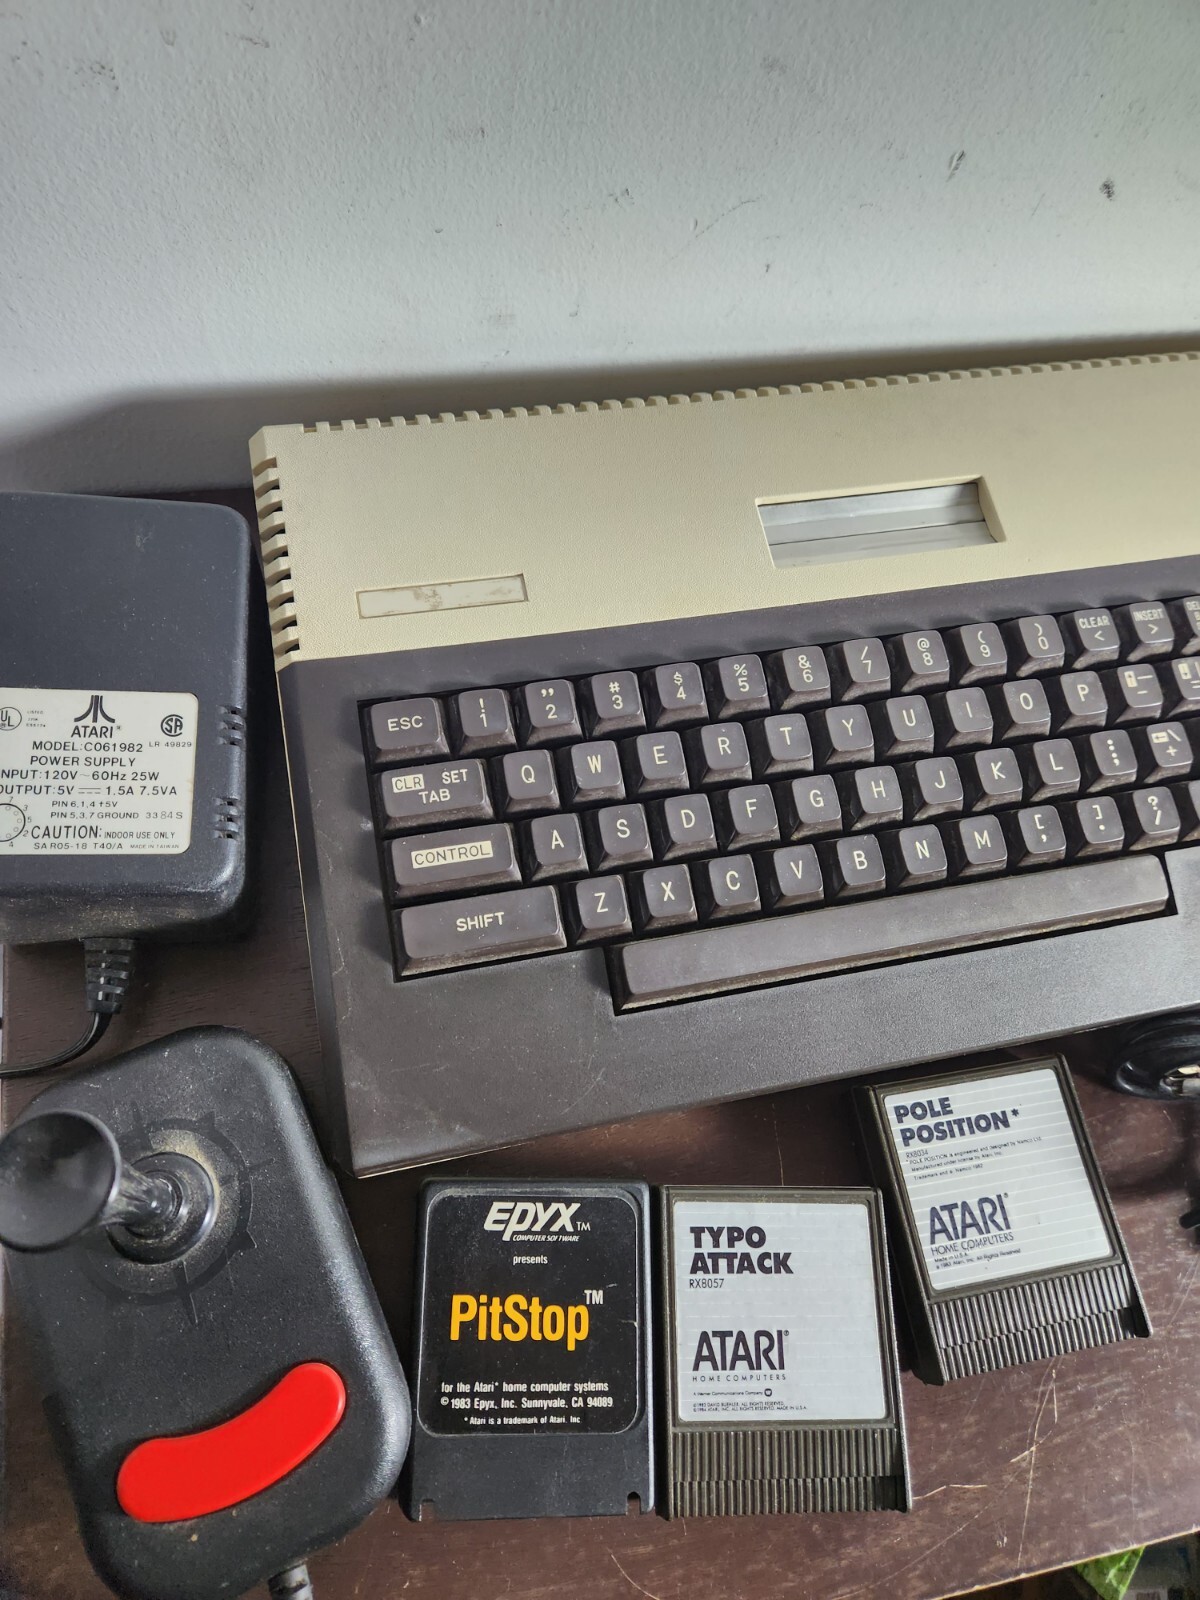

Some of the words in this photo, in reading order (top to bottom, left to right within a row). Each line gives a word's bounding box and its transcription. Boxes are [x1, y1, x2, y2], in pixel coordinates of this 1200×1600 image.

[1079, 616, 1109, 628] CLEAR
[1133, 608, 1163, 621] INSERT
[980, 645, 991, 658] 9
[1038, 636, 1049, 650] 0
[862, 660, 872, 674] 7
[923, 652, 933, 666] 8
[803, 669, 813, 683] 6
[677, 687, 686, 699] 4
[738, 678, 749, 692] 5
[1077, 684, 1089, 701] P
[612, 695, 623, 709] 3
[966, 702, 972, 718] I
[1020, 693, 1033, 710] O
[546, 704, 557, 719] 2
[903, 709, 916, 727] U
[387, 716, 423, 731] ESC
[480, 714, 487, 727] 1
[842, 719, 854, 736] Y
[71, 726, 113, 738] ATARI
[780, 727, 792, 745] T
[718, 737, 731, 755] R
[30, 756, 79, 765] POWER
[84, 757, 135, 767] SUPPLY
[653, 746, 668, 764] E
[1050, 753, 1063, 771] L
[587, 755, 602, 773] W
[991, 762, 1006, 779] K
[92, 771, 126, 780] 60Hz
[131, 772, 159, 781] 25W
[394, 776, 422, 790] CLR
[441, 769, 468, 785] SET
[521, 765, 535, 784] Q
[935, 771, 945, 788] J
[106, 786, 134, 795] 1.5A
[140, 786, 177, 795] 7.5VA
[418, 789, 450, 804] TAB
[871, 780, 886, 798] H
[810, 790, 824, 807] G
[746, 799, 757, 818] F
[681, 810, 695, 828] D
[31, 825, 103, 839] CAUTION:
[617, 819, 630, 838] S
[551, 830, 565, 849] A
[974, 830, 991, 849] M
[414, 844, 491, 865] CONTROL
[915, 840, 929, 859] N
[853, 851, 868, 869] B
[790, 861, 803, 879] V
[726, 871, 741, 890] C
[661, 882, 675, 901] X
[594, 893, 608, 912] Z
[456, 912, 504, 932] SHIFT
[893, 1096, 953, 1124] POLE
[906, 1149, 929, 1158] RX8034
[484, 1202, 580, 1241] EPYX
[930, 1194, 1011, 1245] ATARI
[689, 1225, 766, 1249] TYPO
[930, 1242, 959, 1256] HOME
[961, 1232, 1014, 1251] COMPUTERS
[513, 1255, 548, 1265] presents
[689, 1252, 794, 1275] ATTACK
[689, 1278, 724, 1289] RX8057
[450, 1294, 589, 1351] PitStop
[584, 1290, 604, 1304] TM
[726, 1374, 786, 1382] COMPUTERS
[441, 1382, 453, 1392] for
[456, 1382, 470, 1392] the
[503, 1382, 527, 1392] home
[530, 1382, 571, 1393] computer
[573, 1381, 609, 1393] systems
[451, 1398, 471, 1409] 1983
[501, 1398, 517, 1409] Inc.
[521, 1397, 568, 1411] Sunnyvale,
[571, 1397, 584, 1408] CA
[586, 1397, 613, 1408] 94089
[503, 1417, 538, 1425] trademark
[540, 1416, 547, 1424] of
